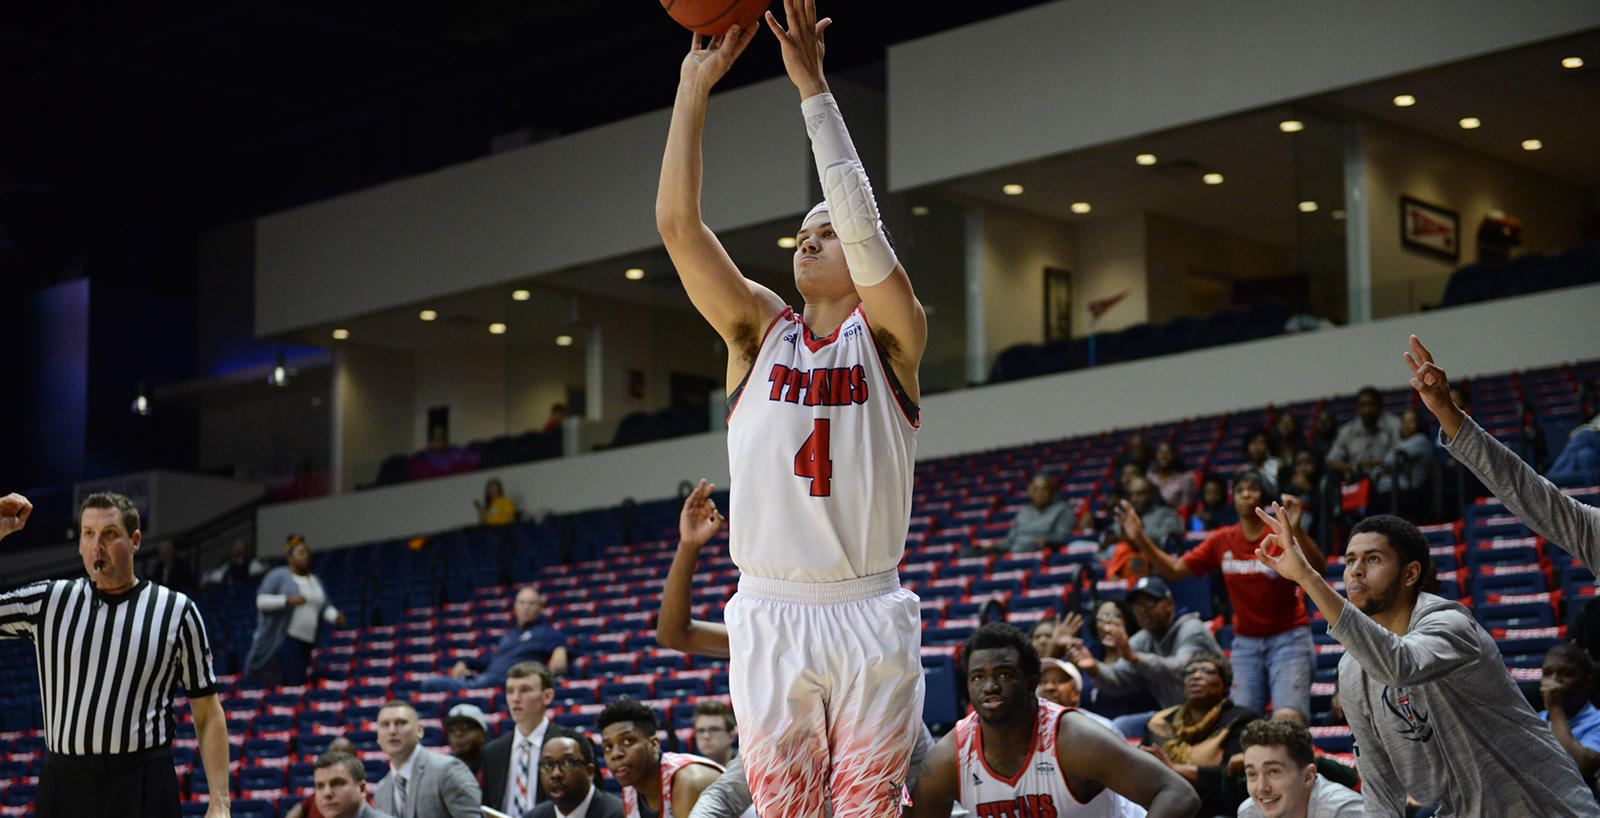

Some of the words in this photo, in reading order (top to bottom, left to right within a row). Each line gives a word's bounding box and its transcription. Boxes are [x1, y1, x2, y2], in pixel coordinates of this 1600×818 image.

[768, 363, 869, 407] TITANS
[794, 418, 832, 497] 4
[976, 793, 1058, 818] TITANS
